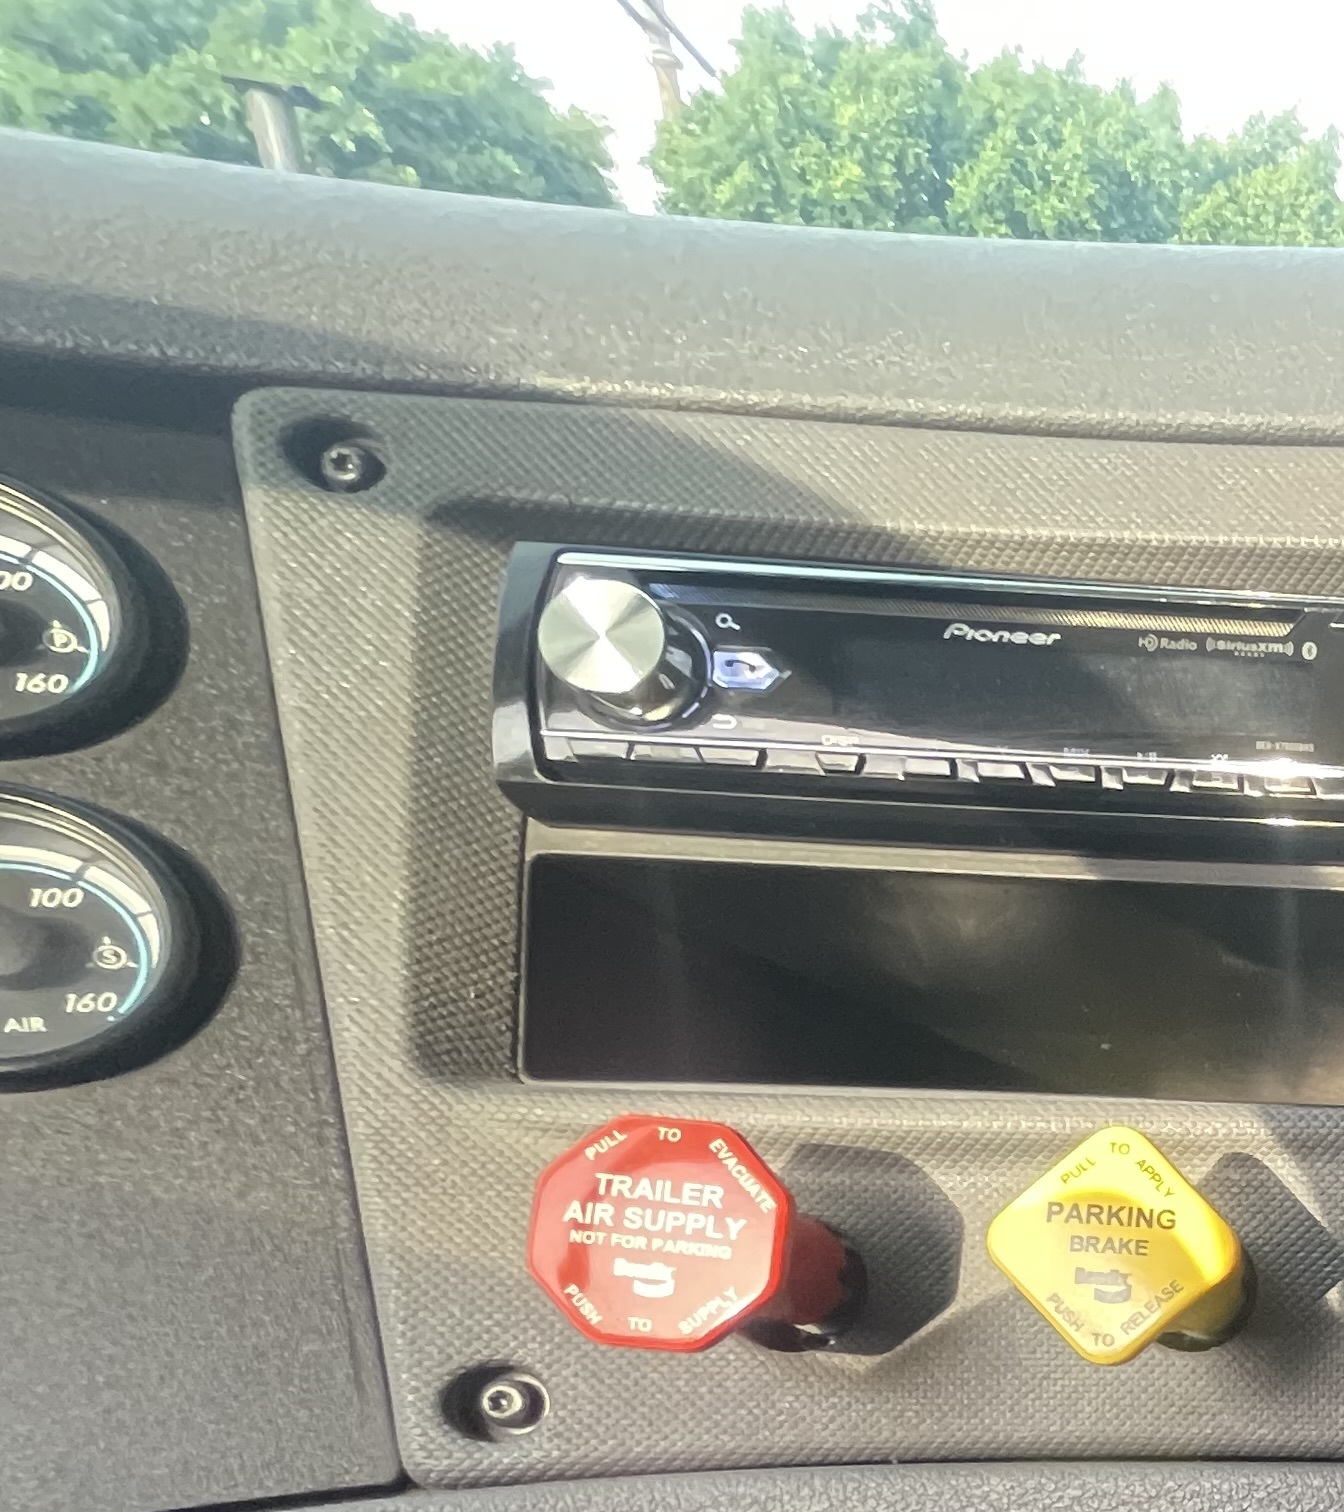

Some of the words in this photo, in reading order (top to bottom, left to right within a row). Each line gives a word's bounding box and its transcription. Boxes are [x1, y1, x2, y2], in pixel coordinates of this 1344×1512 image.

[943, 622, 1061, 646] Pioneer
[1159, 637, 1198, 652] Radio
[15, 672, 69, 694] 160
[28, 888, 84, 908] 100
[65, 992, 118, 1013] 160
[4, 1017, 48, 1033] AIR
[584, 1129, 628, 1160] PULL
[658, 1126, 681, 1142] TO
[709, 1138, 777, 1214] EVACUATE
[1060, 1157, 1096, 1185] PULL
[1110, 1142, 1130, 1155] TO
[1135, 1159, 1175, 1198] APPLY
[595, 1172, 724, 1209] TRAILER
[562, 1200, 615, 1227] AIR
[622, 1206, 748, 1241] SUPPLY
[1046, 1201, 1177, 1230] PARKING
[569, 1229, 608, 1245] NOT
[610, 1233, 648, 1251] FOR
[651, 1237, 733, 1260] PARKING
[1069, 1234, 1150, 1257] BRAKE
[564, 1283, 603, 1325] PUSH
[628, 1316, 653, 1333] TO
[678, 1286, 738, 1335] SUPPLY
[1046, 1292, 1085, 1332] PUSH
[1091, 1332, 1115, 1348] TO
[1120, 1279, 1185, 1335] RELEASE
